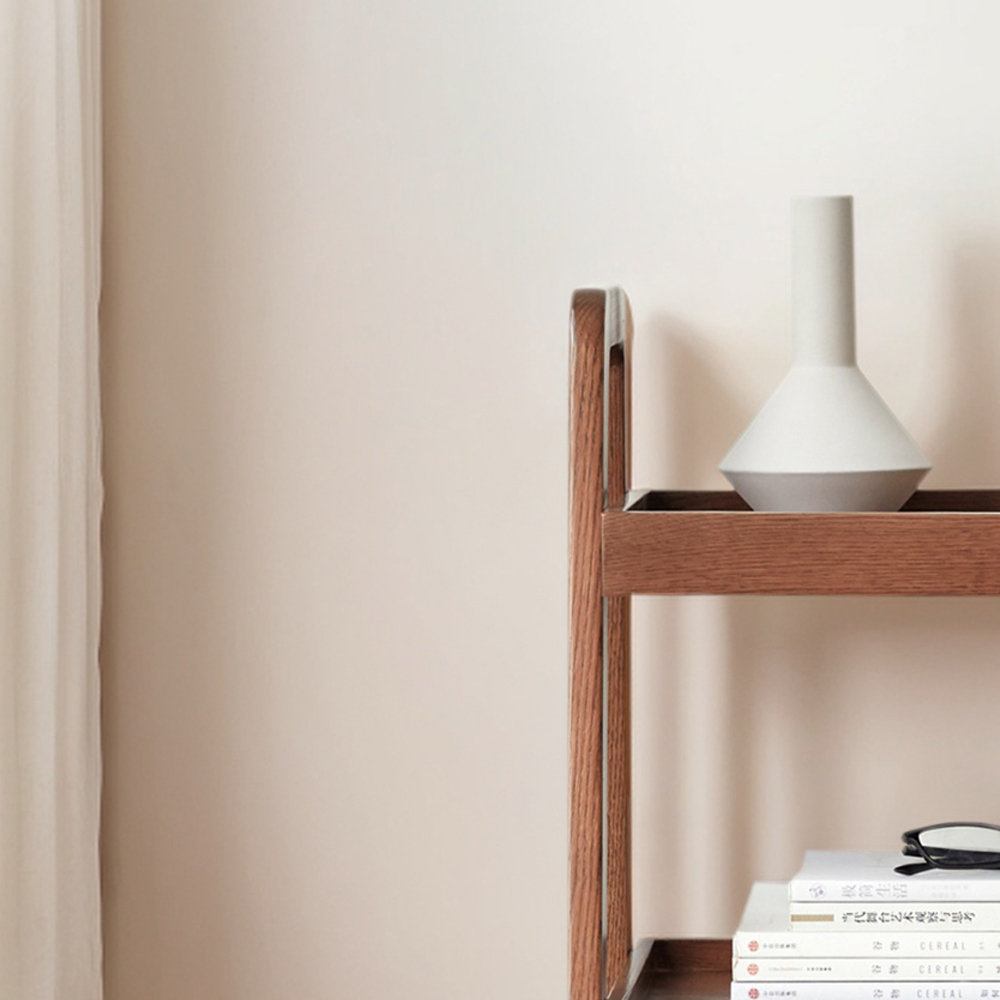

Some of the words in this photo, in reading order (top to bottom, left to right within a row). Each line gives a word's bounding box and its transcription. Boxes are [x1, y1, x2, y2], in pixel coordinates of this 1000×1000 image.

[919, 941, 966, 951] CEREAL
[918, 964, 965, 975] CEREAL
[916, 989, 964, 999] CEREAL
